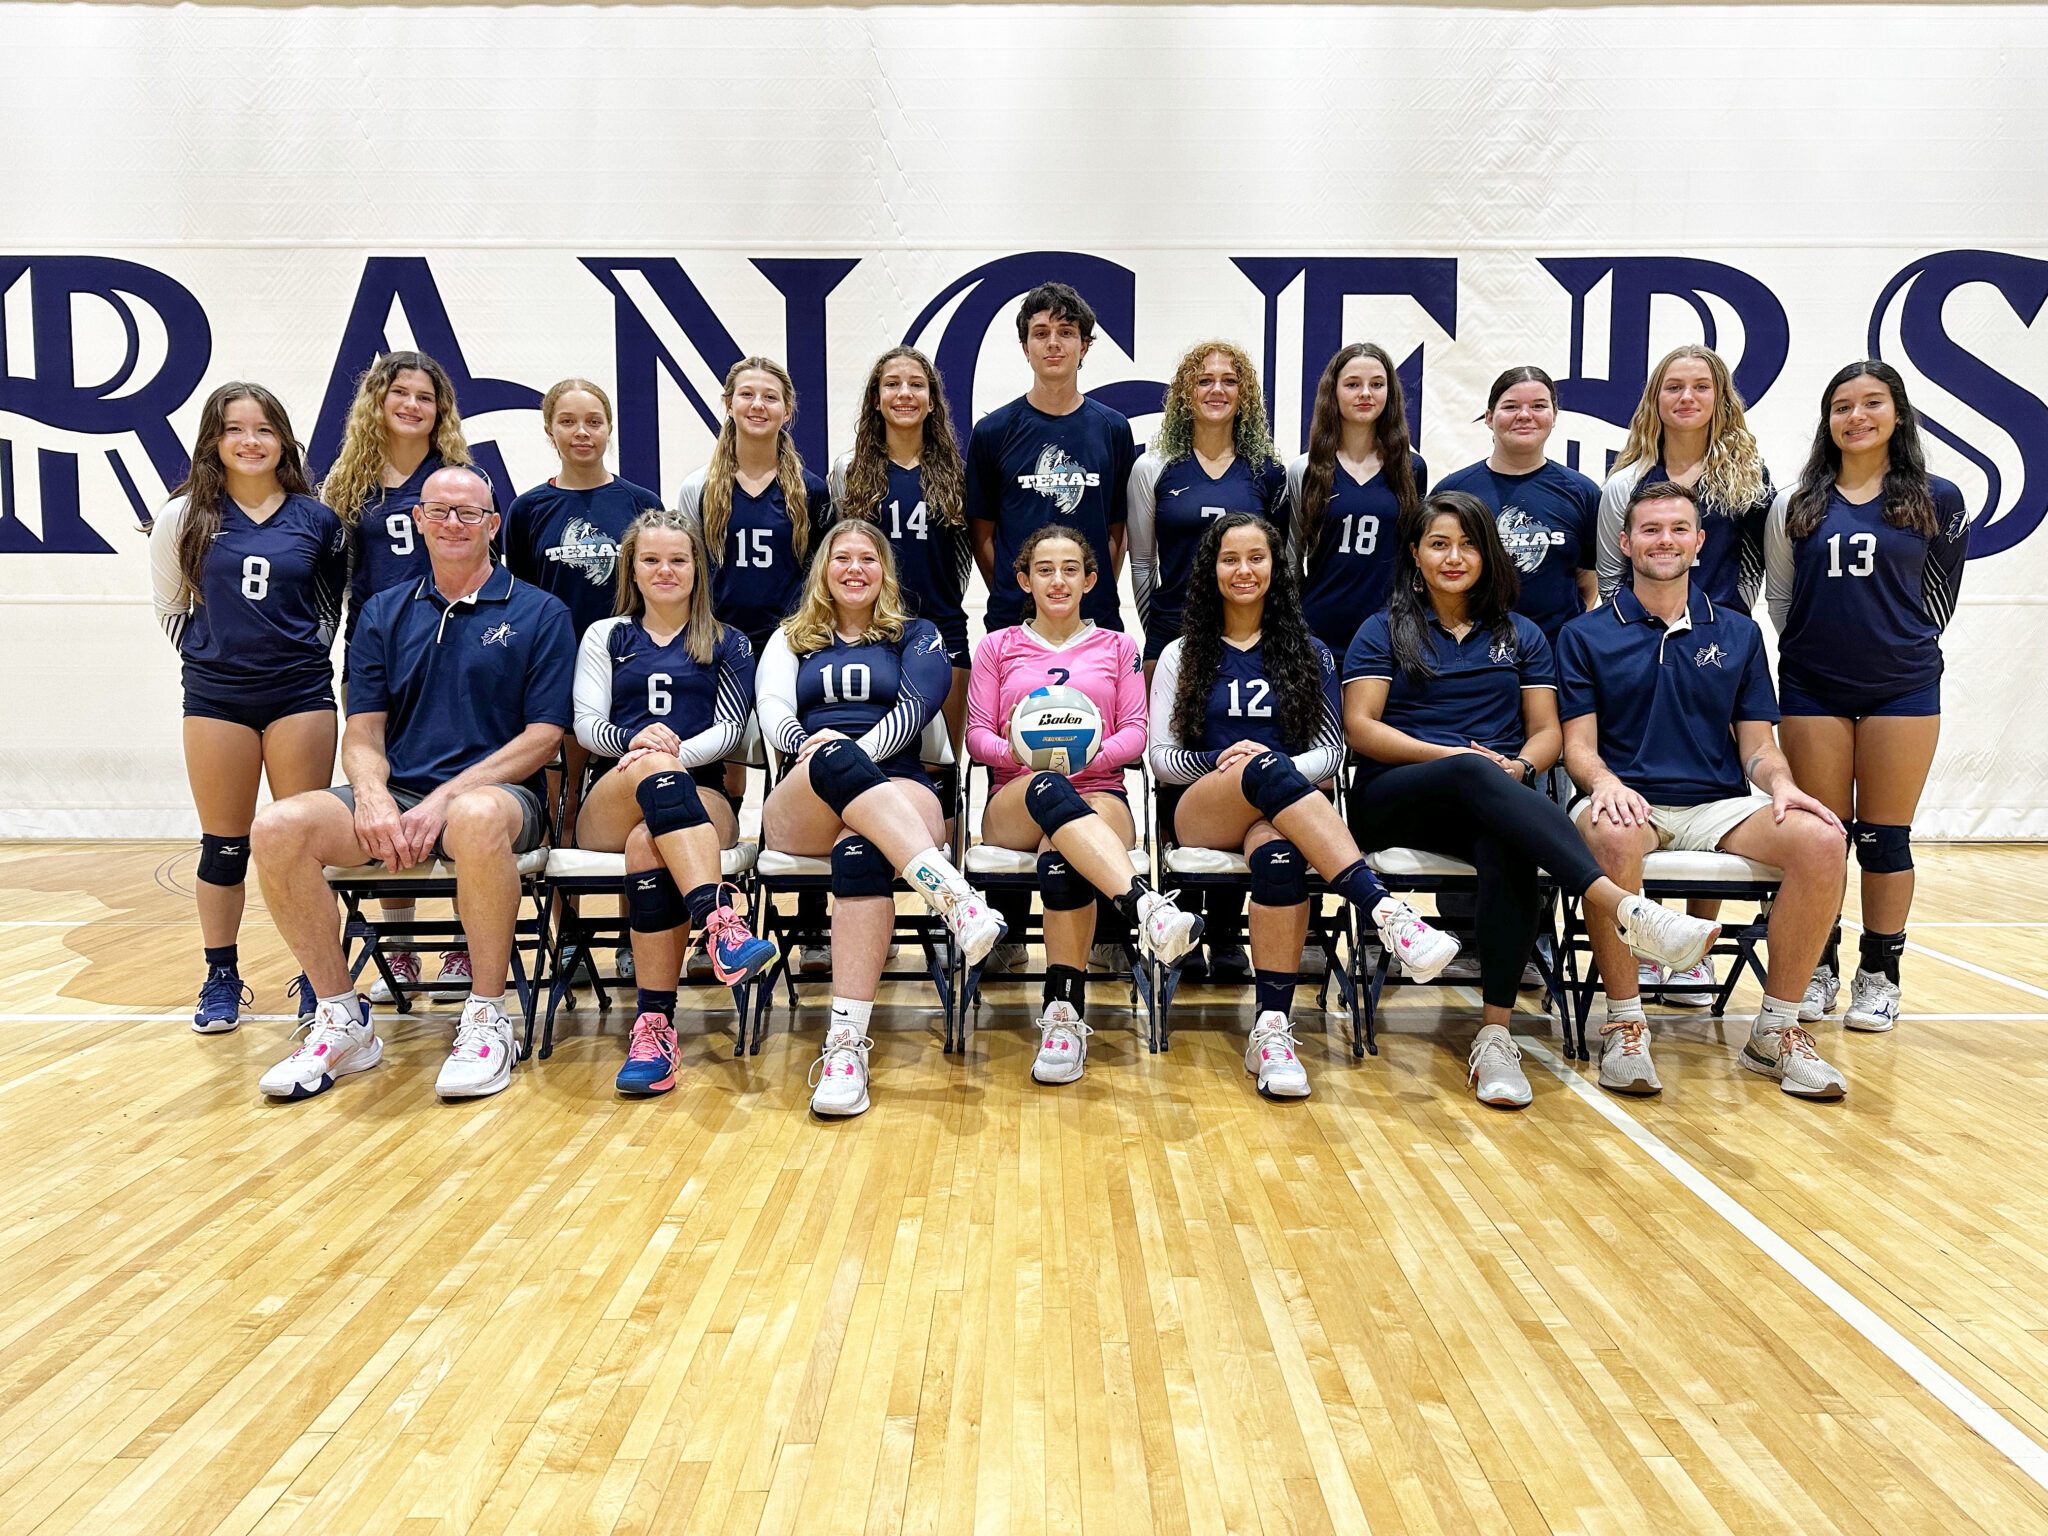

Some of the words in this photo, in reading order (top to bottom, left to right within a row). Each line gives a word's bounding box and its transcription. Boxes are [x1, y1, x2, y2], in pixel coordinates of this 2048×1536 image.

[1018, 472, 1100, 489] TEXAS
[386, 513, 415, 556] 9
[889, 499, 928, 540] 14
[1338, 514, 1380, 555] 18
[1500, 531, 1565, 547] EXAS
[735, 528, 773, 568] 15
[1827, 532, 1877, 578] 13
[241, 555, 270, 601] 8
[647, 672, 673, 716] 6
[819, 663, 871, 704] 10
[1047, 667, 1070, 686] 2
[1227, 678, 1272, 718] 12
[1038, 712, 1083, 726] Baden
